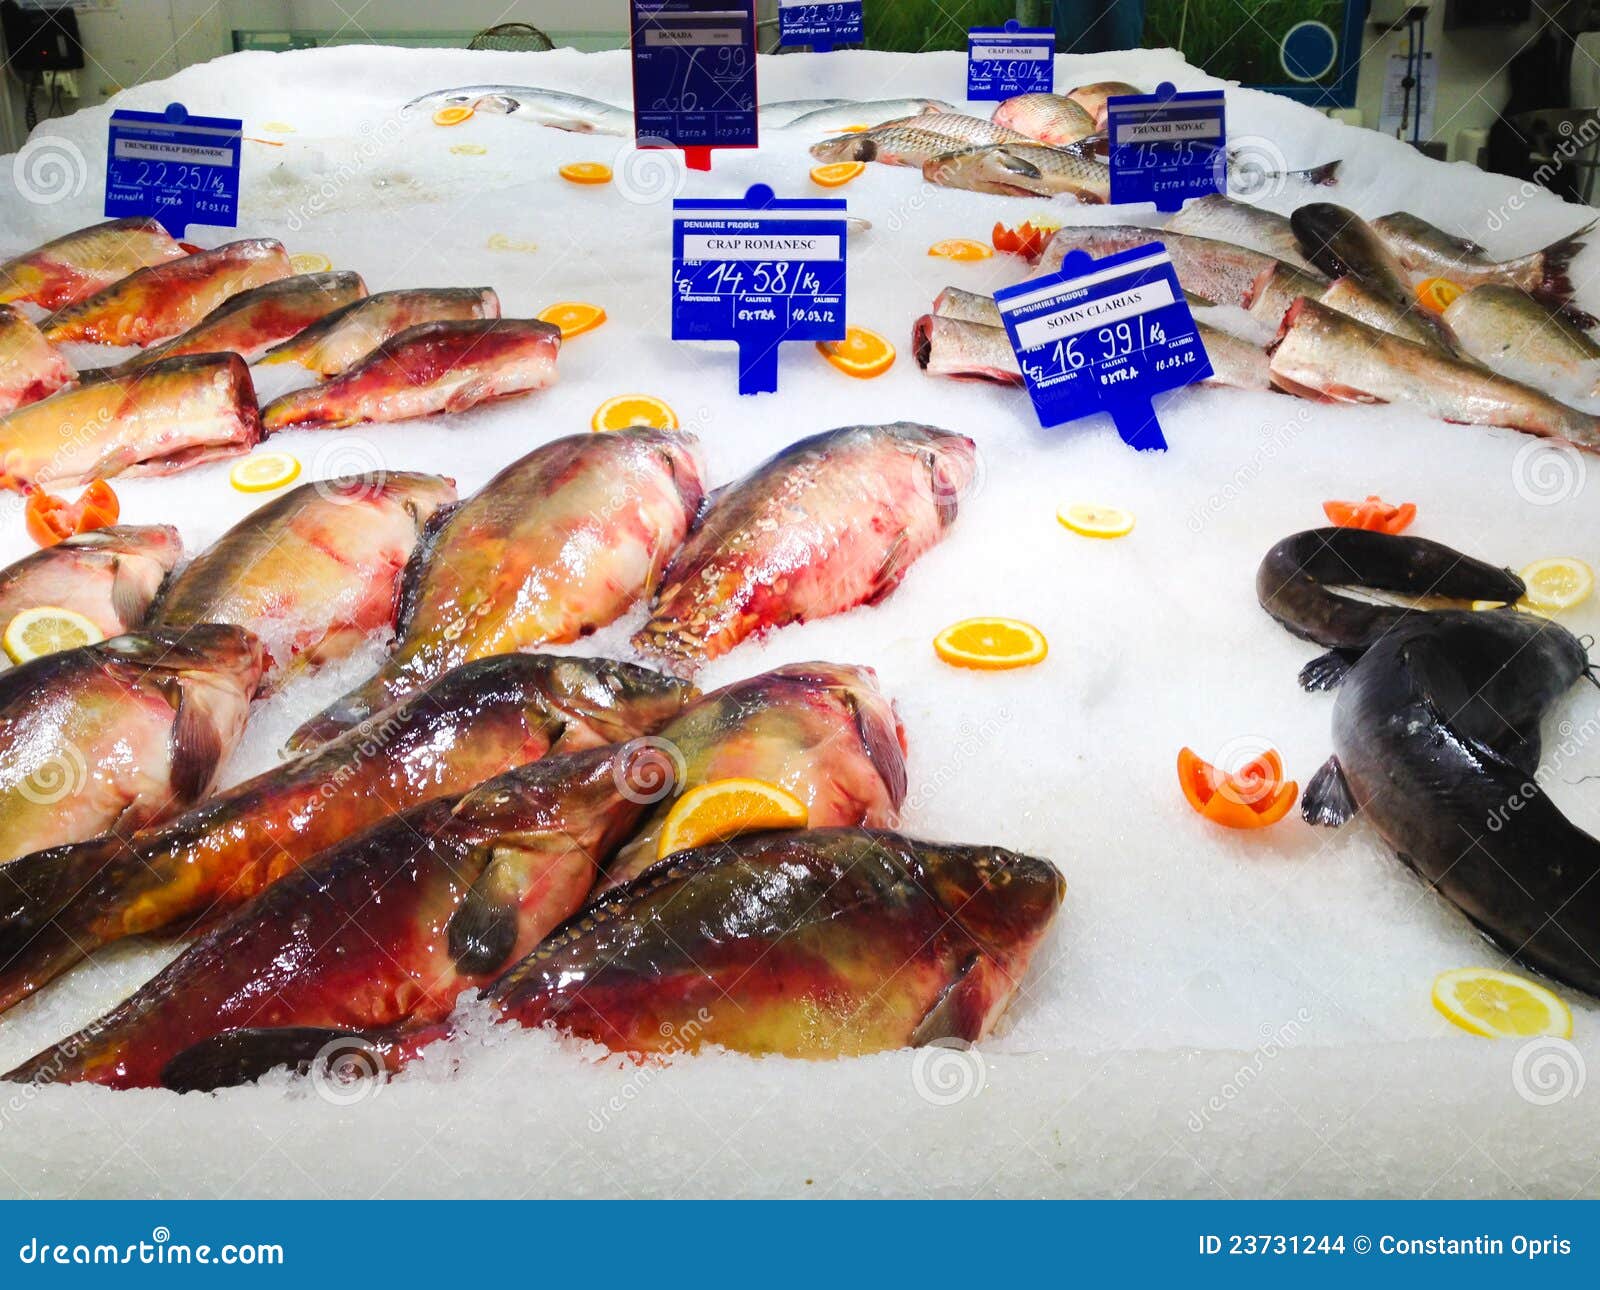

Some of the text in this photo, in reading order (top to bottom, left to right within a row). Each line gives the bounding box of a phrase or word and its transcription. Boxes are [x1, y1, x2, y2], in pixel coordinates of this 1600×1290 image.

[1132, 122, 1206, 134] TRUNCHI NOVAC
[1154, 180, 1185, 192] EXTRA
[683, 221, 726, 229] DENUMIRE
[707, 239, 817, 250] CRAP ROMANESC
[1056, 288, 1089, 304] PRODUS
[738, 310, 776, 321] EXTRA
[1047, 293, 1143, 330] SOMN CLARIAS
[1168, 337, 1194, 349] CALIBRU
[1101, 356, 1128, 369] CALITATE
[1101, 366, 1139, 385] EXTRA
